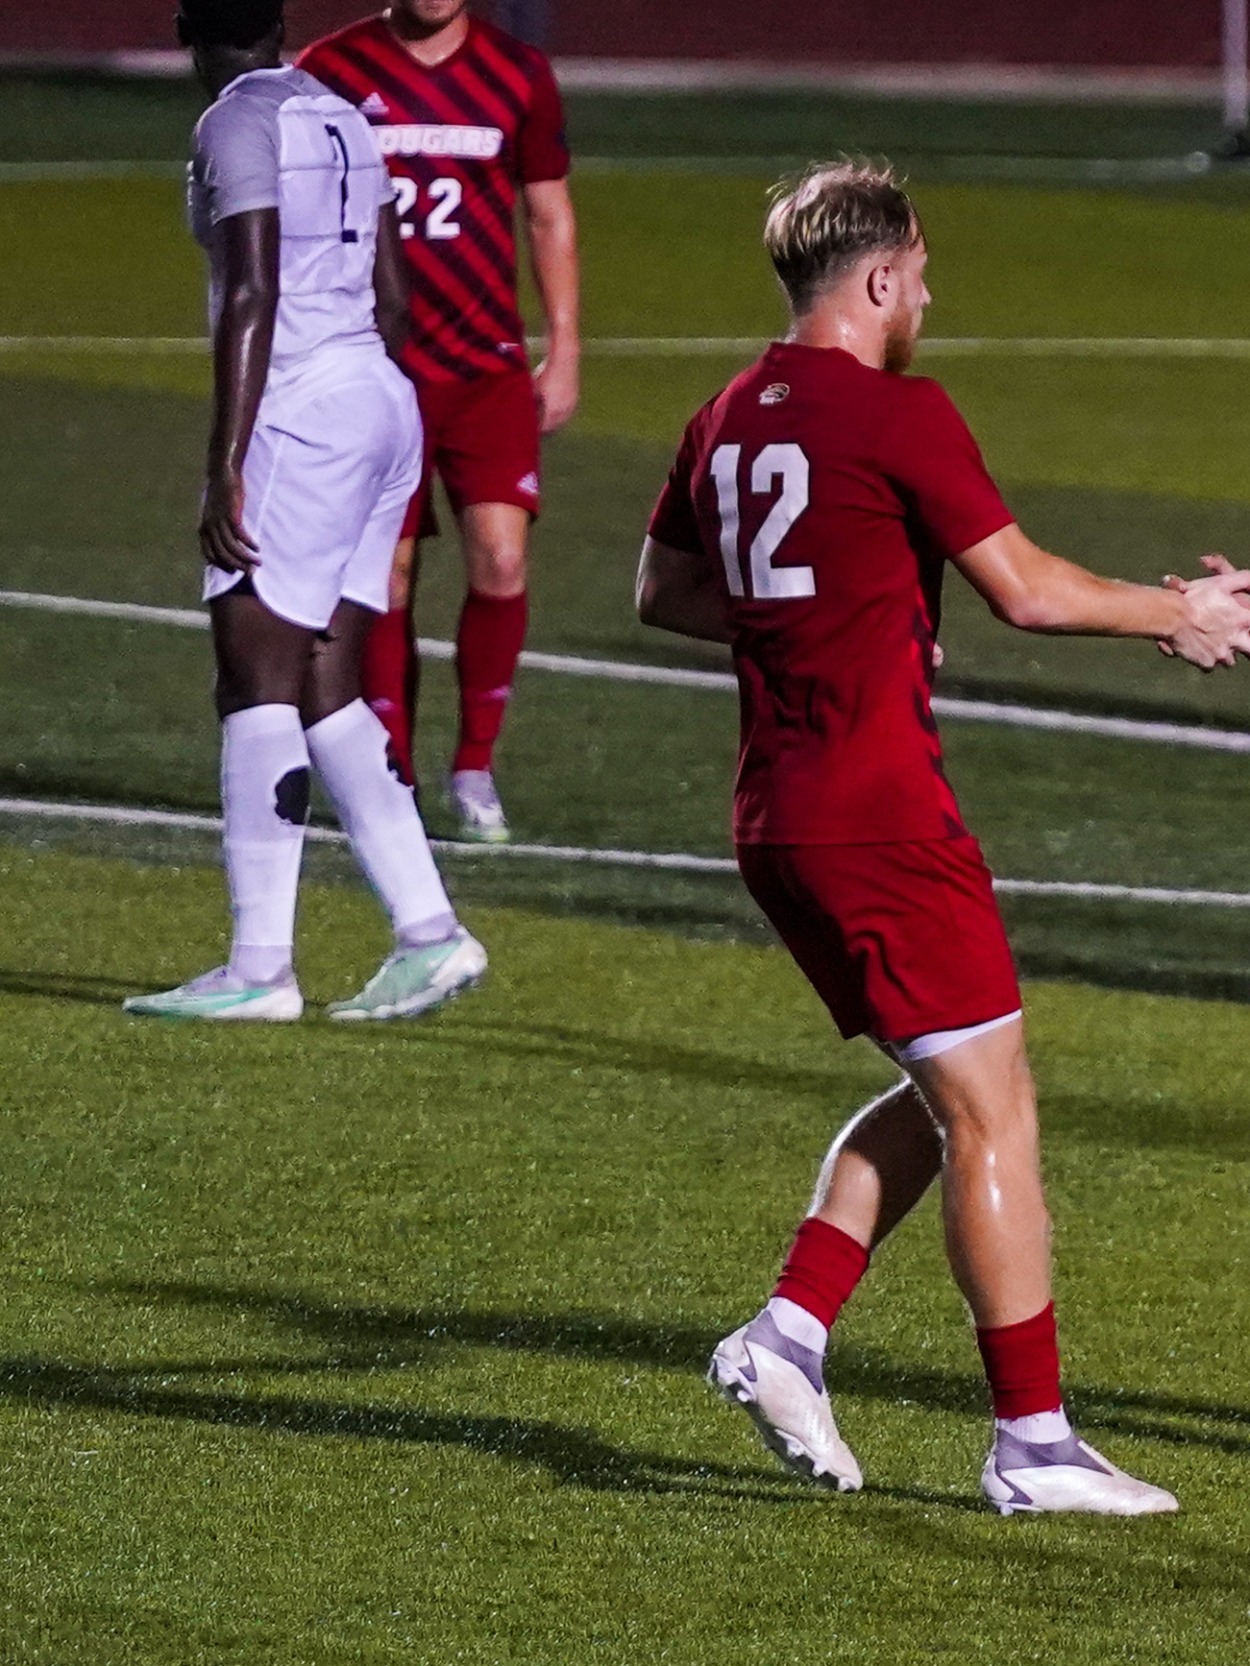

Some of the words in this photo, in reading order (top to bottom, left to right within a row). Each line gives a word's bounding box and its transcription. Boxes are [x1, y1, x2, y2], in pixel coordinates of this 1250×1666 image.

[325, 124, 358, 242] 1
[373, 125, 503, 160] OUGARS
[710, 443, 816, 598] 12
